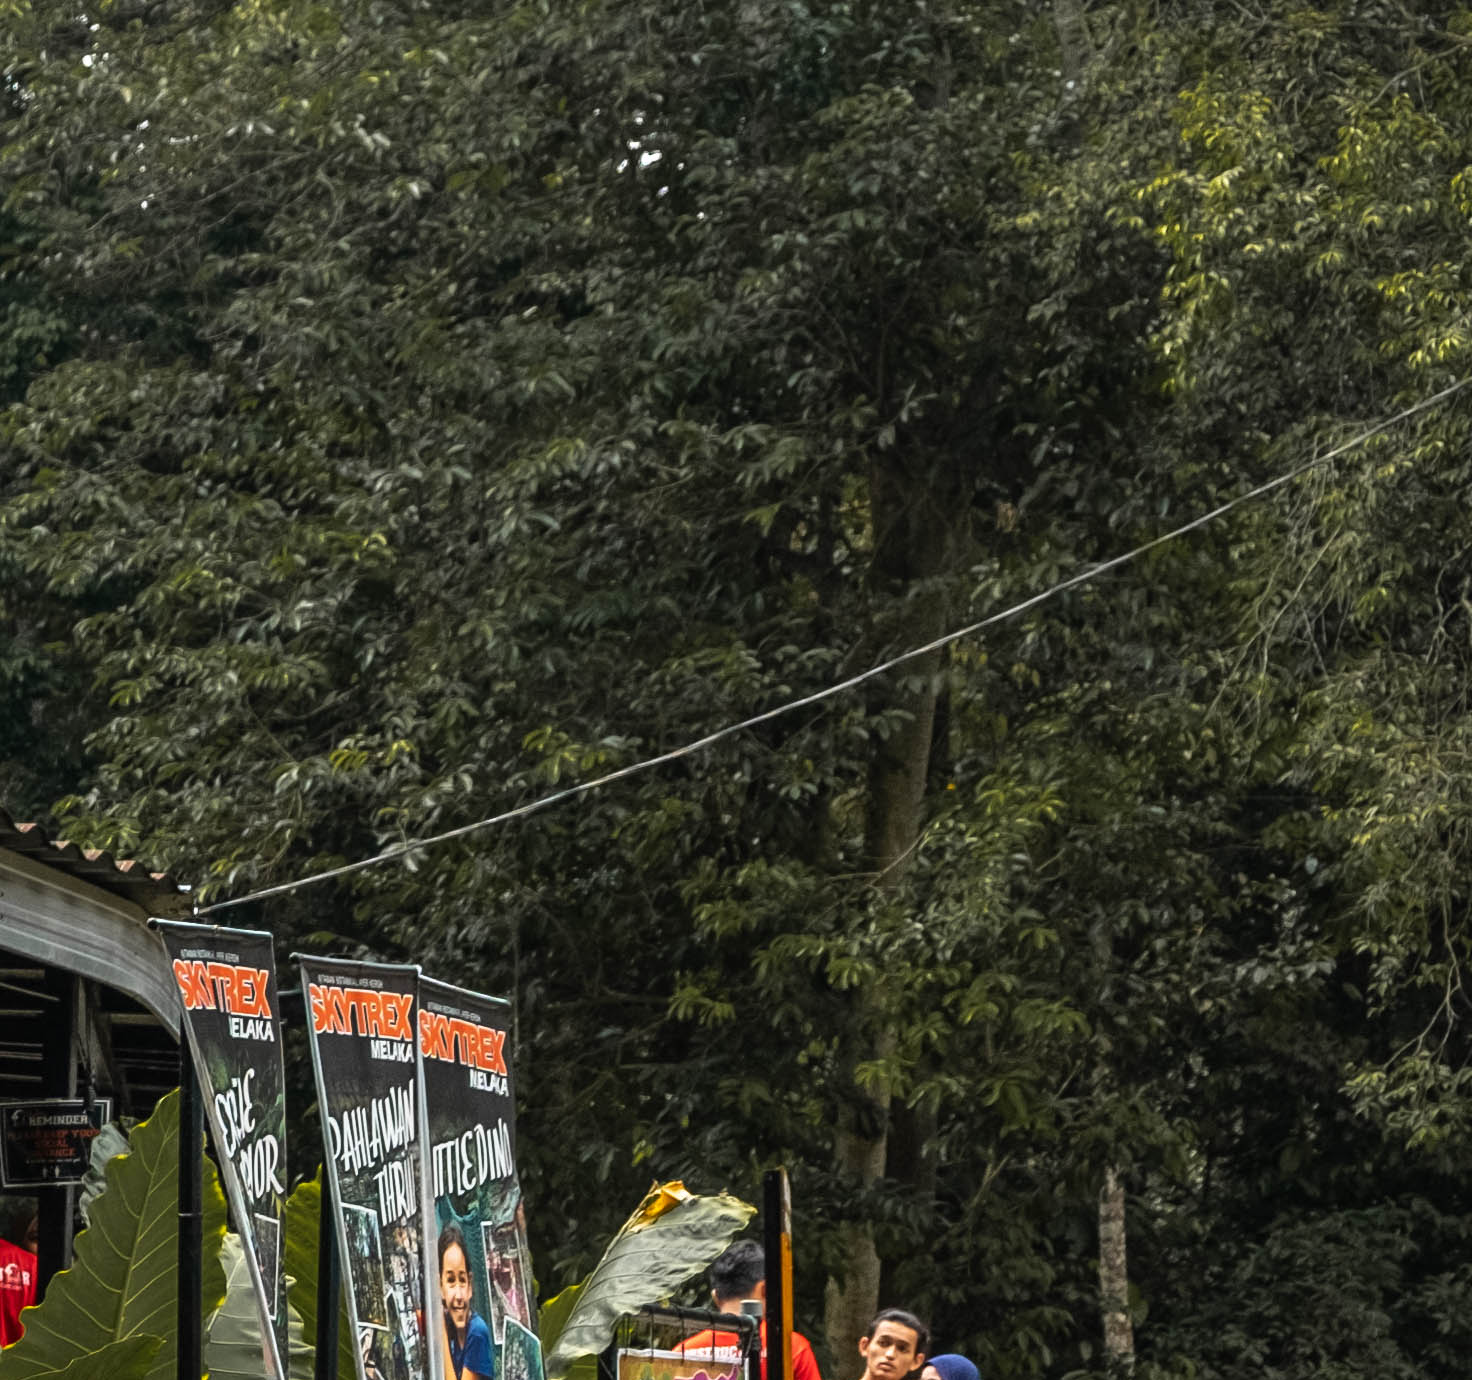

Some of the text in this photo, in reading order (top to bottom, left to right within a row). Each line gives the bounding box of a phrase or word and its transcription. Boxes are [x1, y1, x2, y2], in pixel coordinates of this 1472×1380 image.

[172, 958, 273, 1019] SKYTREX
[309, 983, 414, 1041] SKYTREX
[228, 1015, 275, 1042] ELAKA
[370, 1040, 415, 1063] MELAKA
[418, 1008, 509, 1076] SKYTREX
[432, 1130, 476, 1198] ITTLE
